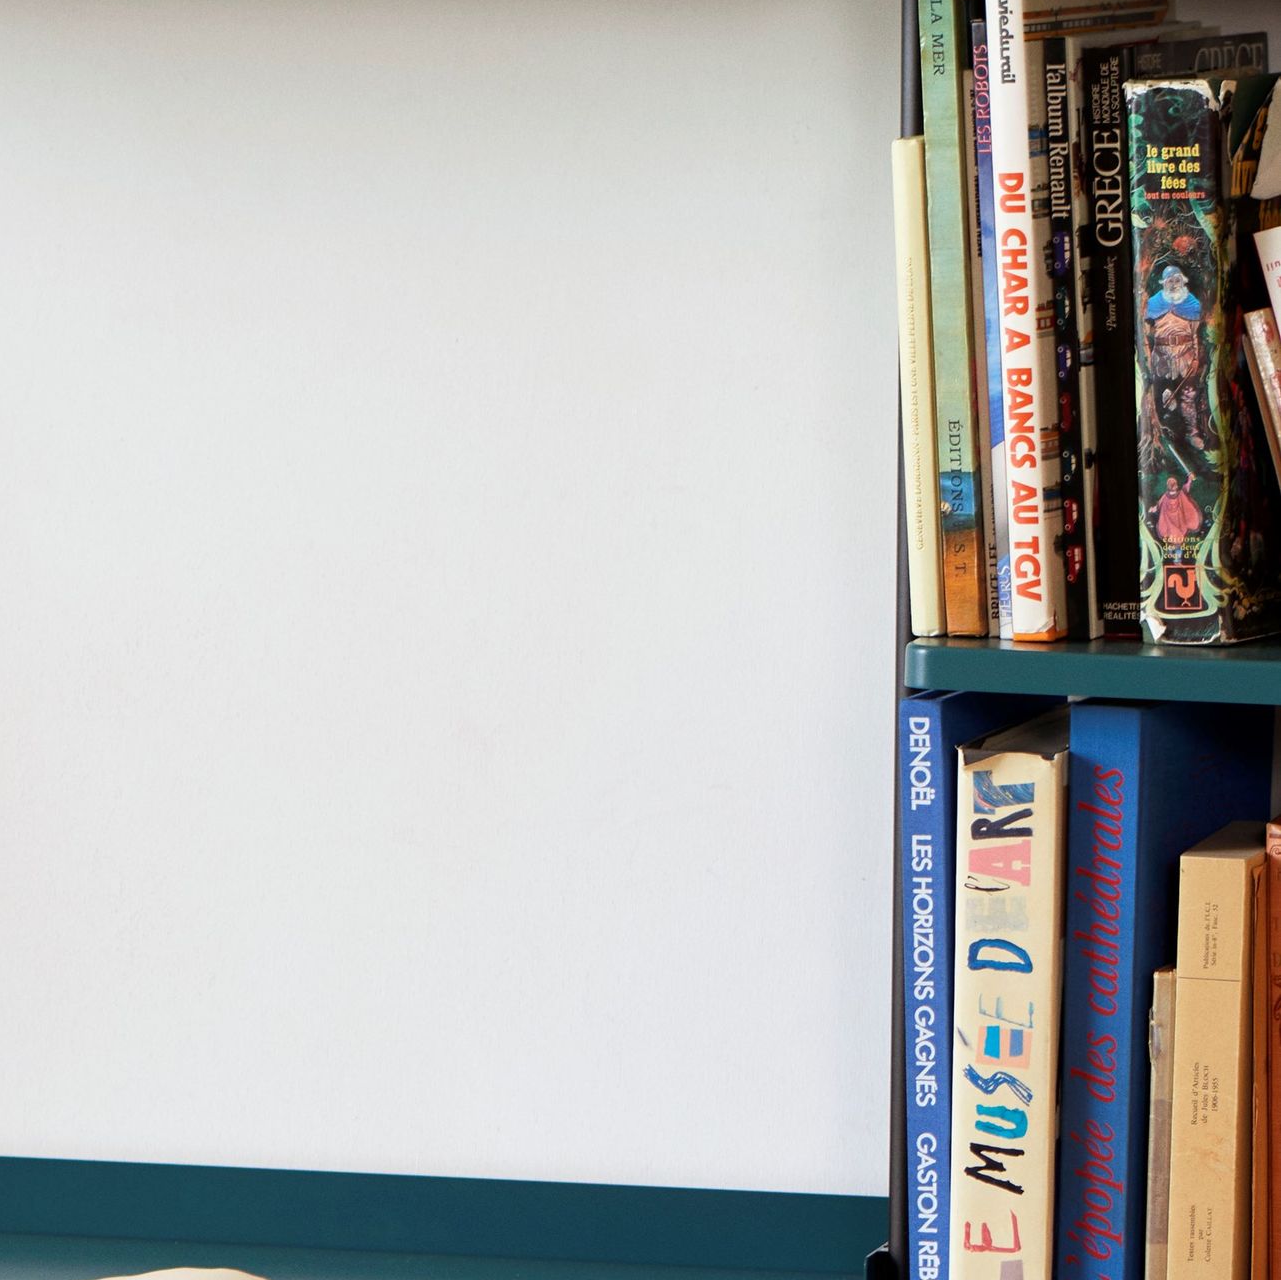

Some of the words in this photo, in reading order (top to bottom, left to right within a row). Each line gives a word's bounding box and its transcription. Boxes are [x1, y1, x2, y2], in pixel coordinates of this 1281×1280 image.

[930, 0, 941, 25] LA
[932, 33, 946, 77] MER
[972, 43, 991, 121] ROBOTS
[1100, 61, 1110, 76] DE
[1044, 63, 1068, 138] l'album
[1099, 76, 1111, 125] MONDIALE
[1109, 110, 1120, 125] LA
[977, 124, 993, 155] LES
[1146, 144, 1158, 159] le
[1160, 143, 1200, 159] grand
[1146, 160, 1176, 175] livre
[1178, 160, 1201, 174] des
[998, 172, 1026, 214] DU
[1048, 142, 1071, 220] Renault
[1160, 176, 1187, 190] fées
[1000, 228, 1030, 317] CHAR
[1004, 327, 1030, 353] A
[1006, 369, 1037, 469] BANCS
[947, 419, 964, 514] ÉDITIONS
[1011, 480, 1040, 526] AU
[1013, 536, 1043, 602] TGV
[909, 717, 936, 811] DENOËL
[911, 834, 933, 872] LES
[1074, 764, 1124, 1017] cathédrales
[912, 877, 935, 1001] HORIZONS
[913, 1005, 938, 1108] GAGNÉS
[1070, 1031, 1119, 1103] des
[957, 992, 1034, 1195] MUSÉE
[916, 1132, 939, 1234] GASTON
